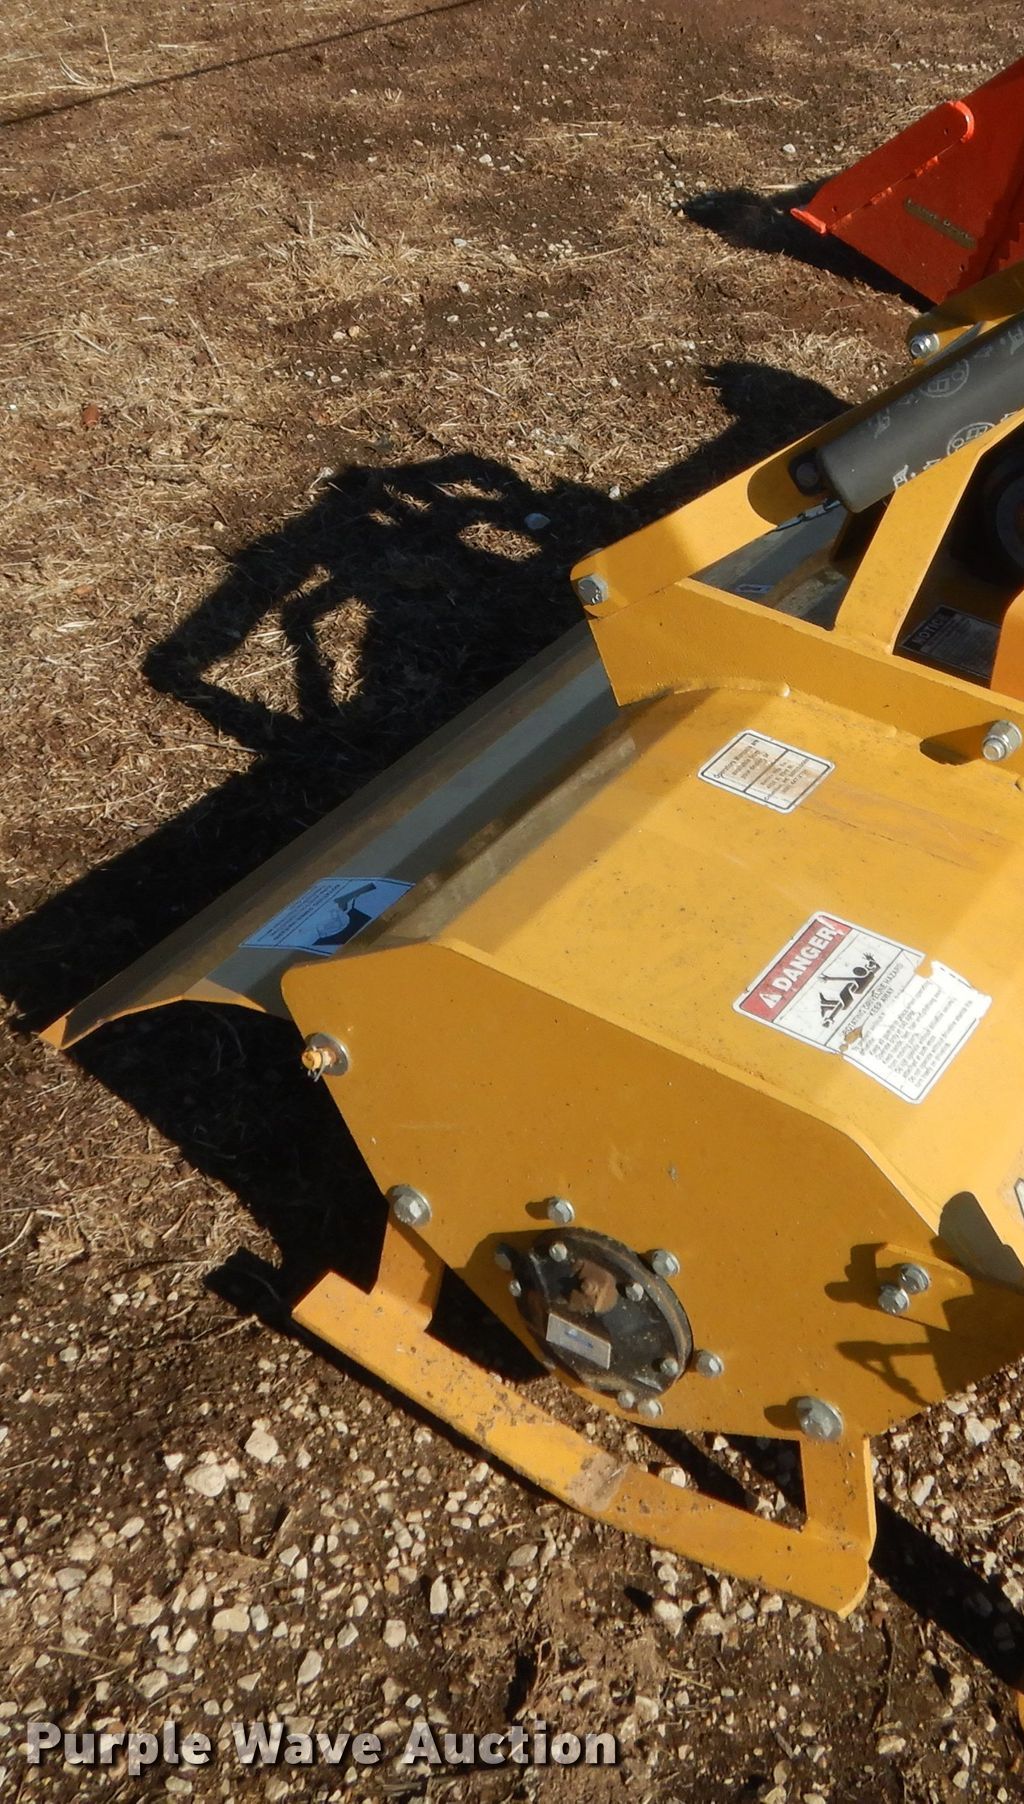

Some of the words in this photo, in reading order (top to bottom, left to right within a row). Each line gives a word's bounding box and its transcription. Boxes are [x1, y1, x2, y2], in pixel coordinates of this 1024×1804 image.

[773, 924, 835, 992] DANGER
[867, 1000, 883, 1017] KEEP
[878, 986, 895, 1003] AWAY
